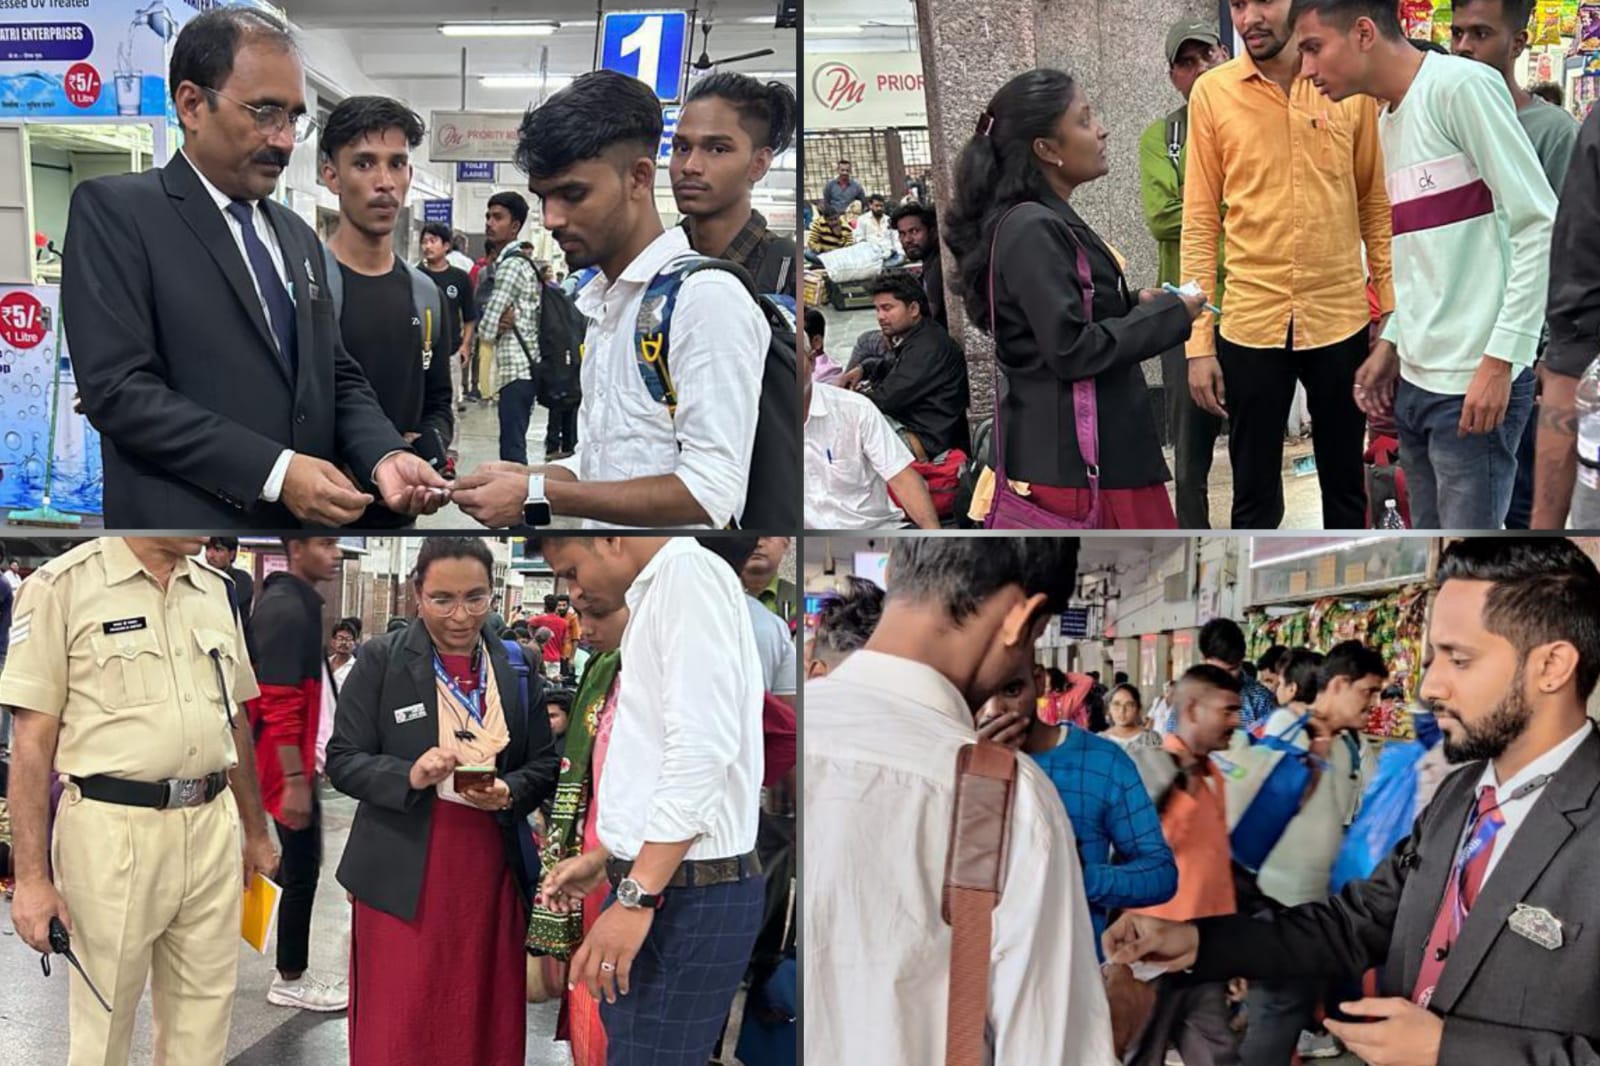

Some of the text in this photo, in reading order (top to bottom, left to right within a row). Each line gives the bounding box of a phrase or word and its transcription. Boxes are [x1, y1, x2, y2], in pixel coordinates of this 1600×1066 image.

[21, 26, 84, 41] ENTERPRISES
[620, 15, 664, 94] 1
[826, 66, 866, 110] PM
[1418, 168, 1435, 189] ck
[6, 331, 39, 342] 1 Litre
